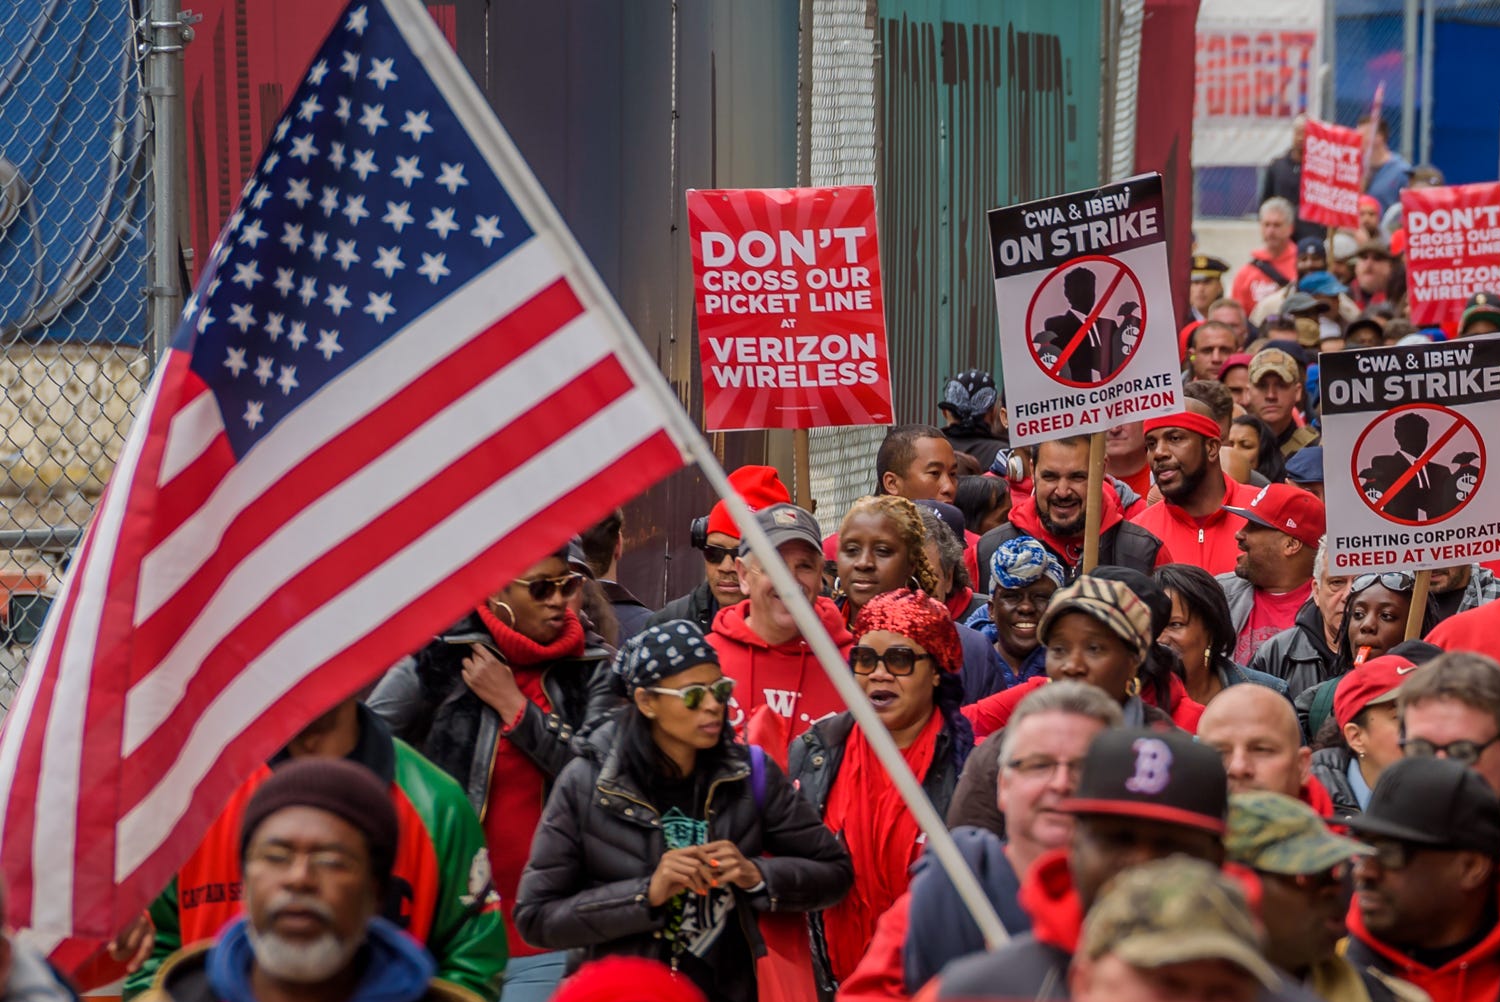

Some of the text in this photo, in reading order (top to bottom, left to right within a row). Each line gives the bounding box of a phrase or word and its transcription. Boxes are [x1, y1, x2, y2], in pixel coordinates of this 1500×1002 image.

[1025, 193, 1130, 229] CWA & IBEW
[701, 227, 866, 267] DON'T
[1000, 208, 1158, 266] ON STRIKE
[1409, 231, 1464, 247] CROSS
[1410, 245, 1464, 260] PICKET
[703, 267, 870, 291] CROSS OUR
[704, 290, 872, 314] PICKET LINE
[781, 319, 796, 328] AT
[709, 333, 877, 363] VERIZON
[1358, 349, 1473, 373] CWA & IBEW
[712, 361, 879, 388] WIRELESS
[1016, 373, 1172, 418] FIGHTING CORPORATE
[1329, 378, 1374, 405] ON
[1016, 391, 1175, 437] GREED AT VERIZON
[1336, 533, 1410, 549] FIGHTING
[1336, 551, 1397, 567] GREED
[1403, 549, 1425, 563] AT
[1125, 736, 1173, 795] B
